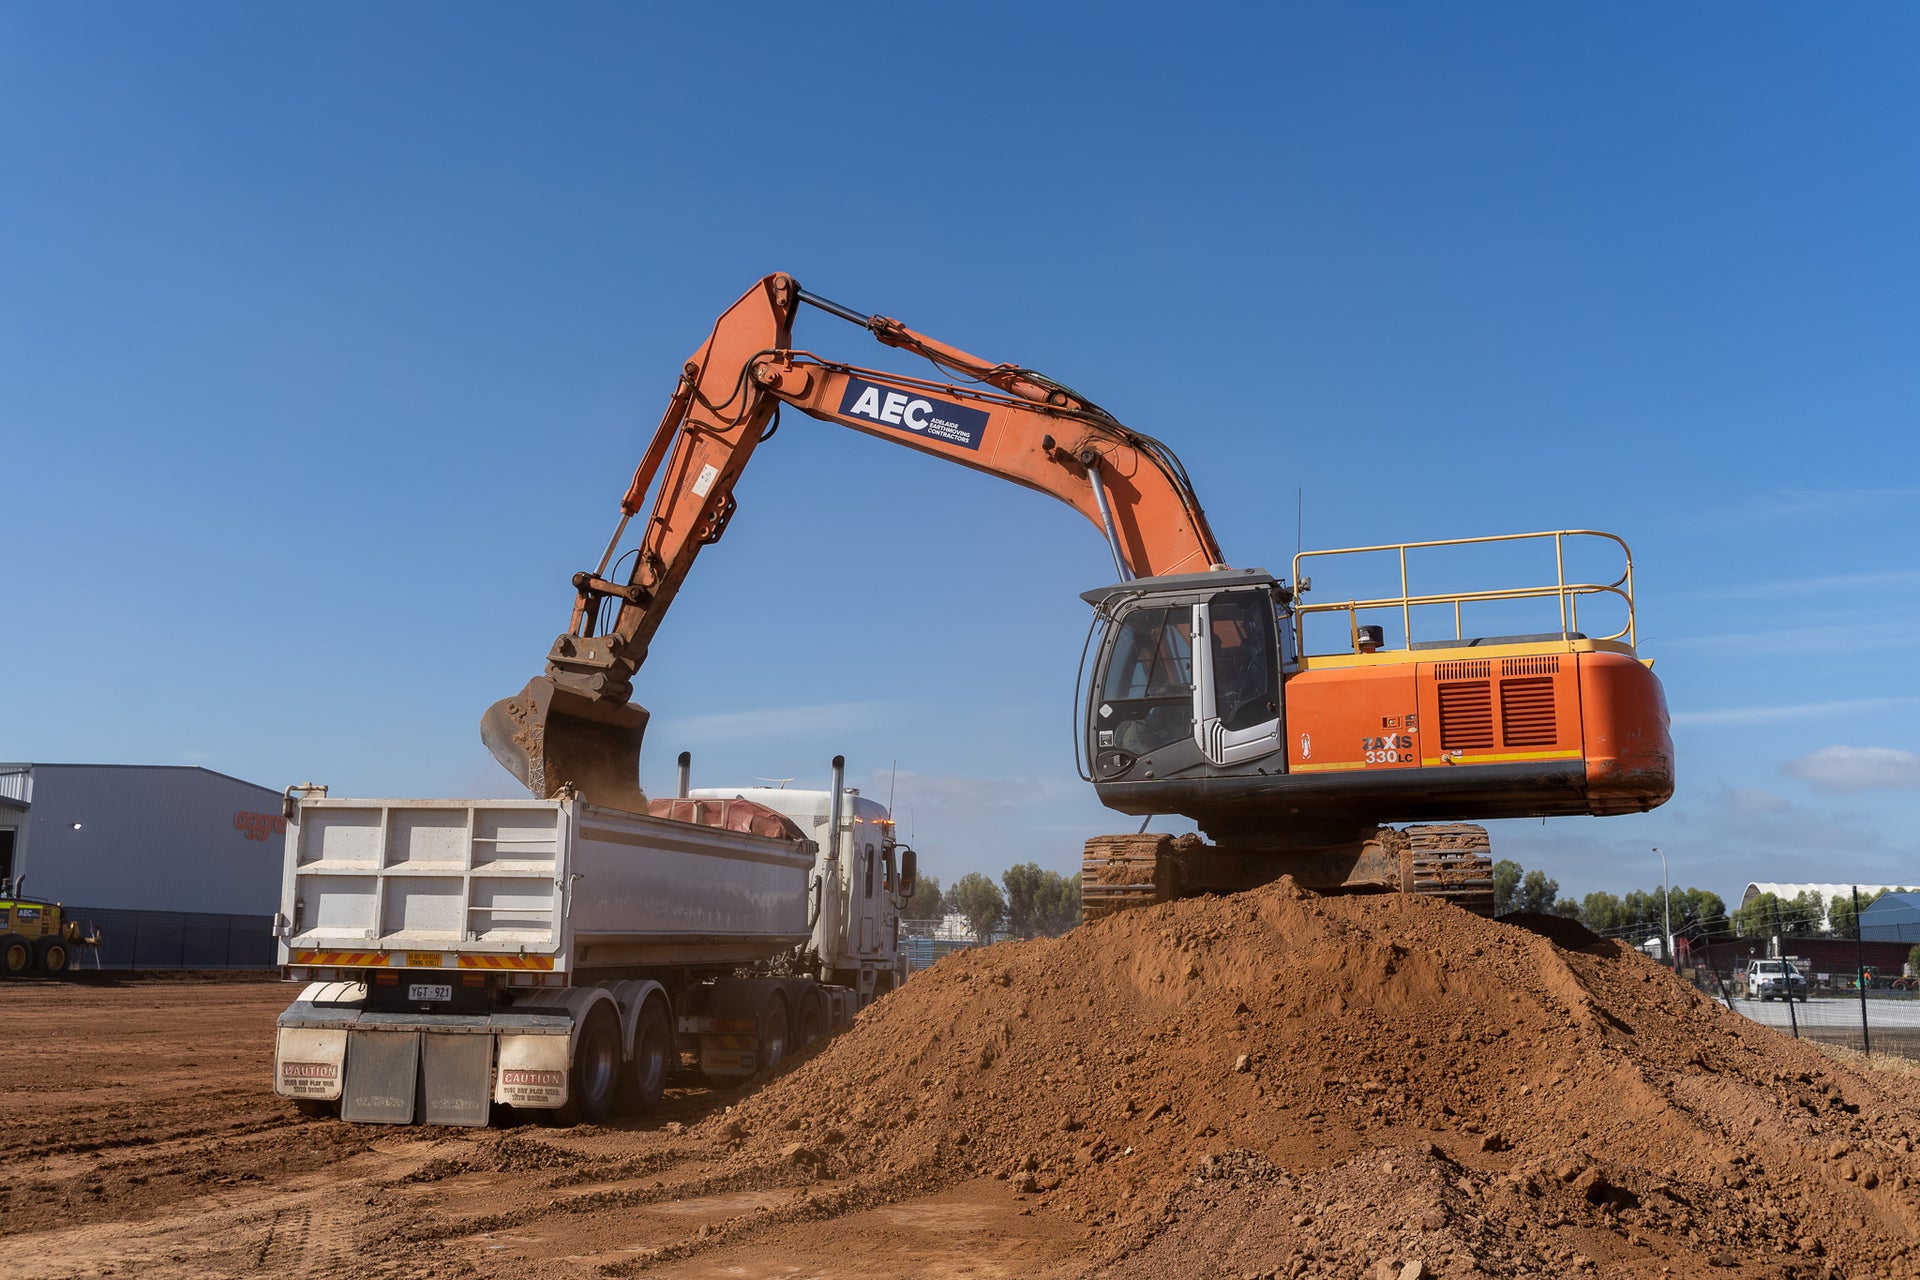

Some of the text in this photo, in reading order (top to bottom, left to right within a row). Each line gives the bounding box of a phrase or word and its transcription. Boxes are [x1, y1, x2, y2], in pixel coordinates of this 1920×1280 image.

[849, 386, 933, 430] AEC
[931, 418, 958, 429] ADELAIDE
[928, 428, 969, 443] CONTRACTORS
[929, 423, 970, 437] EARTHMOVING
[1362, 733, 1412, 750] ZAXIS
[18, 909, 32, 917] AEC
[283, 1065, 335, 1076] CAUTION
[505, 1073, 560, 1084] CAUTION
